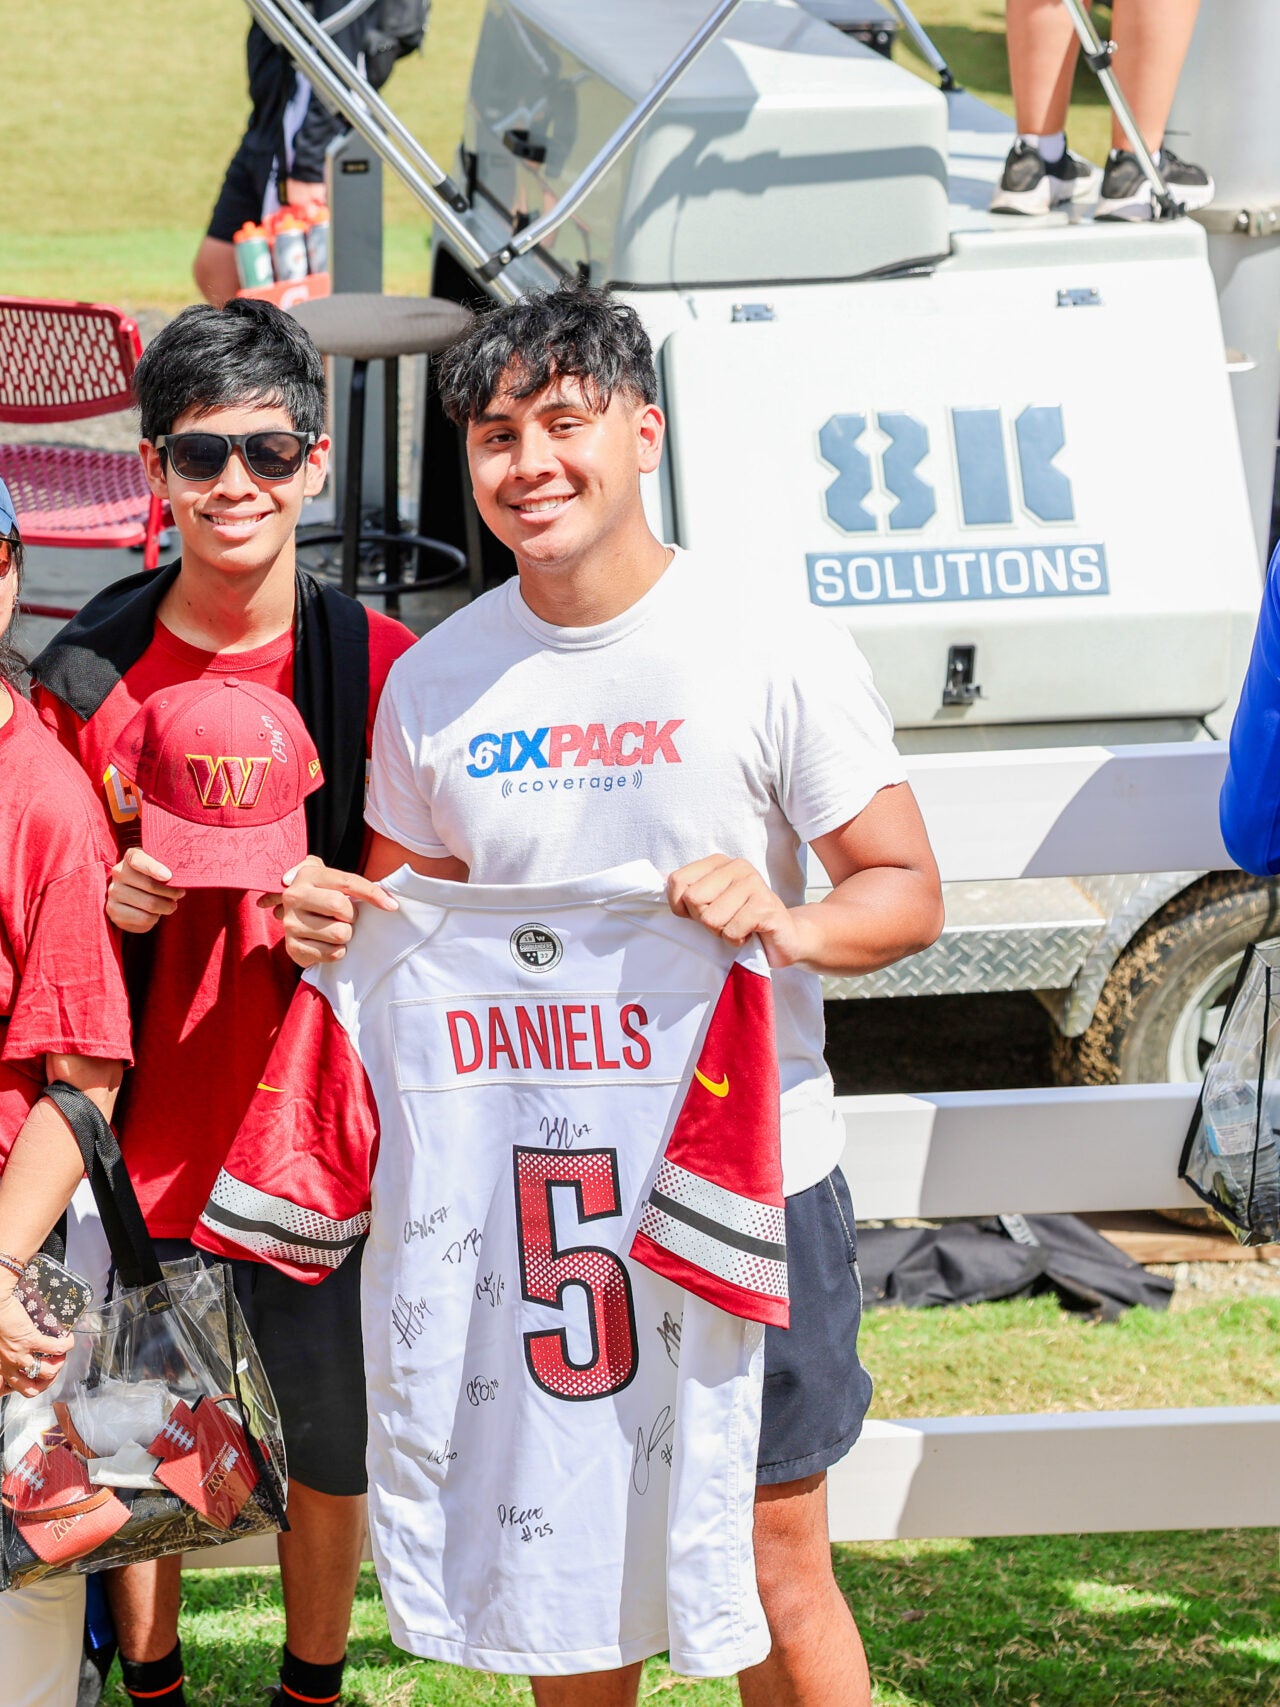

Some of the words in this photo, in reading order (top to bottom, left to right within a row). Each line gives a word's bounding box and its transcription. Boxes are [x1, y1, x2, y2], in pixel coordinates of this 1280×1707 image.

[814, 546, 1103, 602] SOLUTIONS
[466, 719, 685, 779] SIXPACK
[518, 774, 627, 792] coverage
[446, 1004, 652, 1075] DANIELS
[512, 1144, 640, 1402] 5
